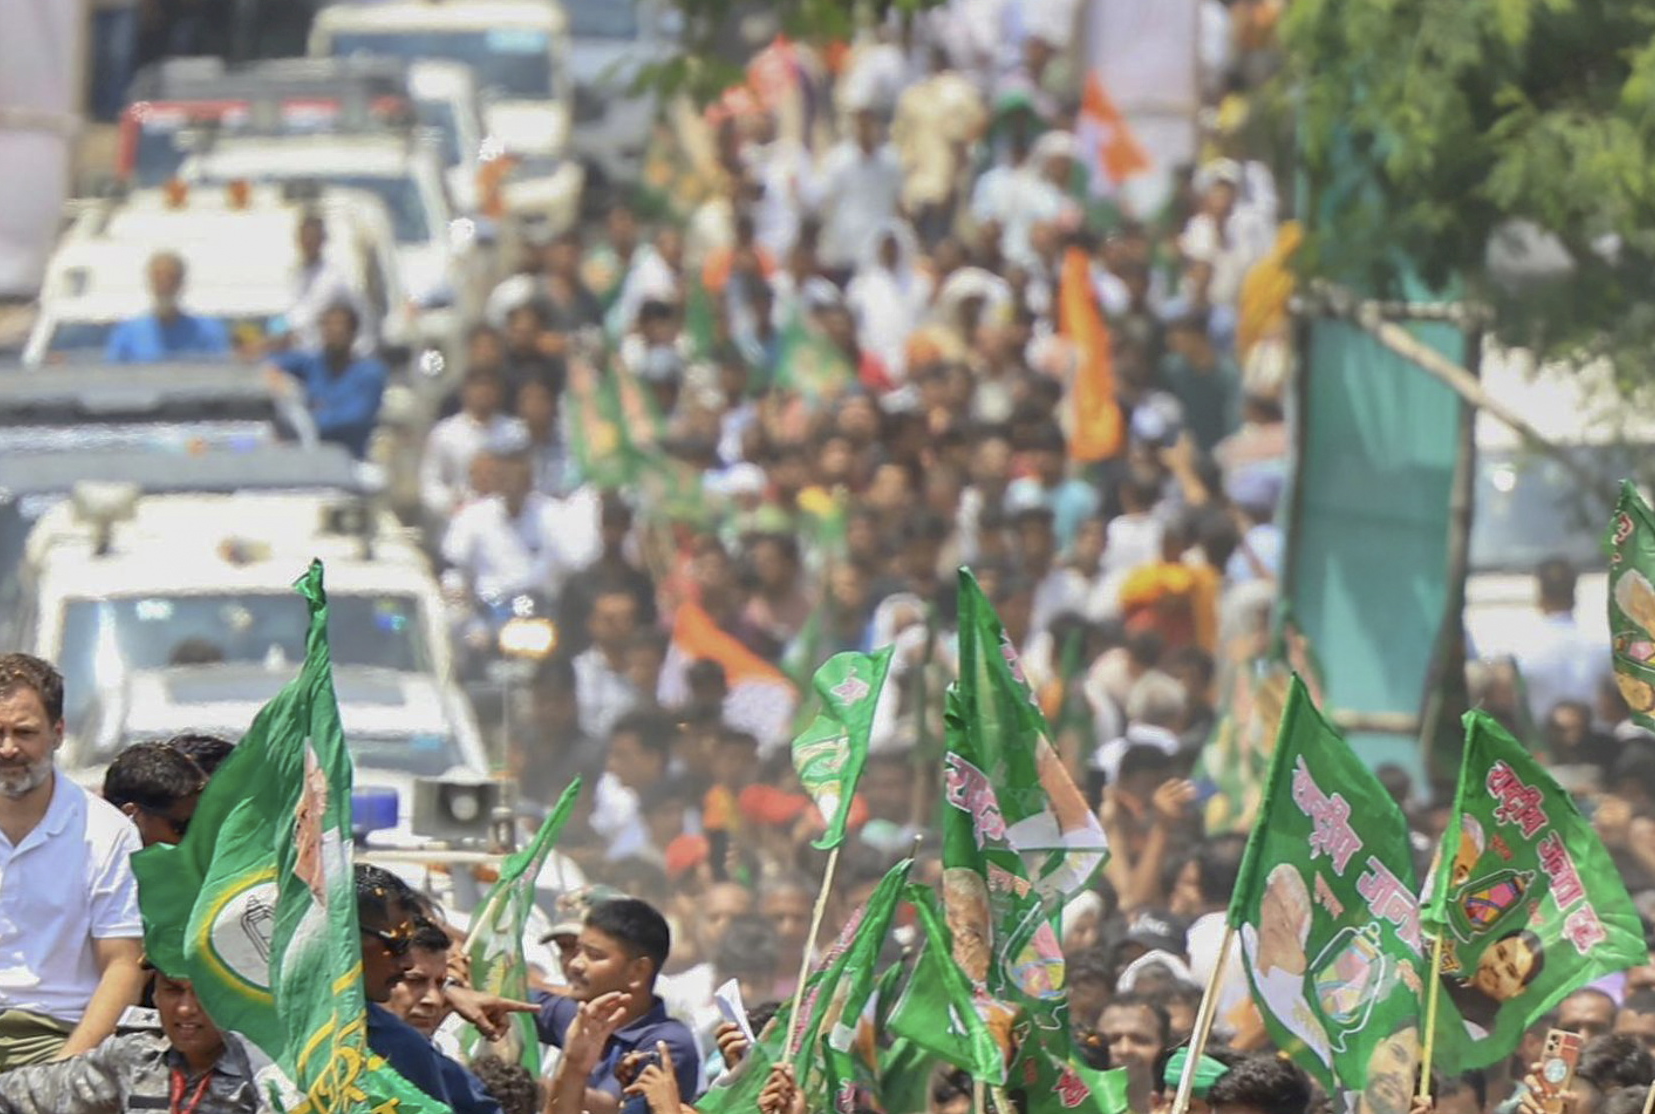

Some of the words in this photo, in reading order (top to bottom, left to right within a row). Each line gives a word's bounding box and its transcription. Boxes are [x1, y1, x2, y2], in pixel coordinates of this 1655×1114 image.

[1485, 759, 1549, 841] राष्ट्रीय
[1536, 829, 1586, 912] जनता
[1562, 900, 1608, 955] दल
